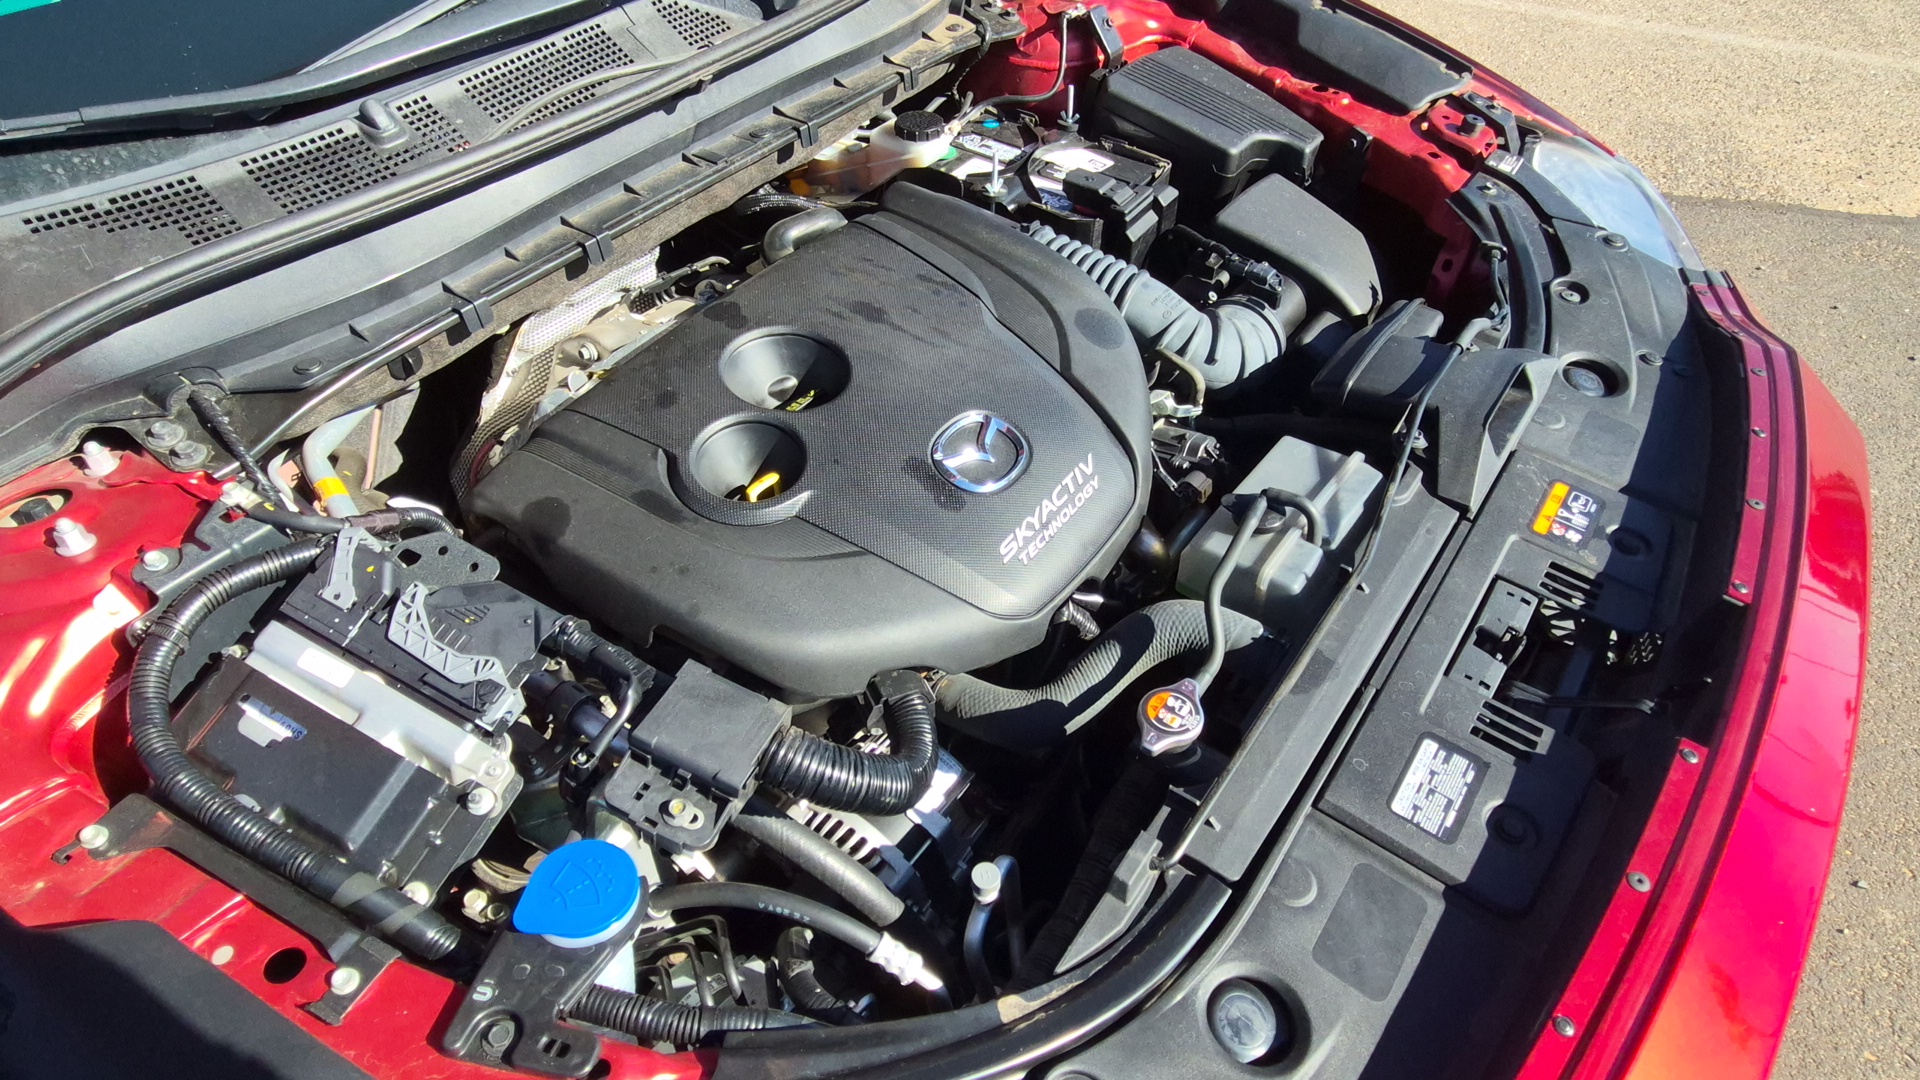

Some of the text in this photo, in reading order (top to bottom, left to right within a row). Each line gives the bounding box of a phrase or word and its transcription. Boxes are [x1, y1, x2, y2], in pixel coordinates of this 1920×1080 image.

[1000, 453, 1094, 564] SKYACTIV
[1019, 475, 1099, 566] TECHNOLOGY
[1395, 781, 1411, 805] CAUTION
